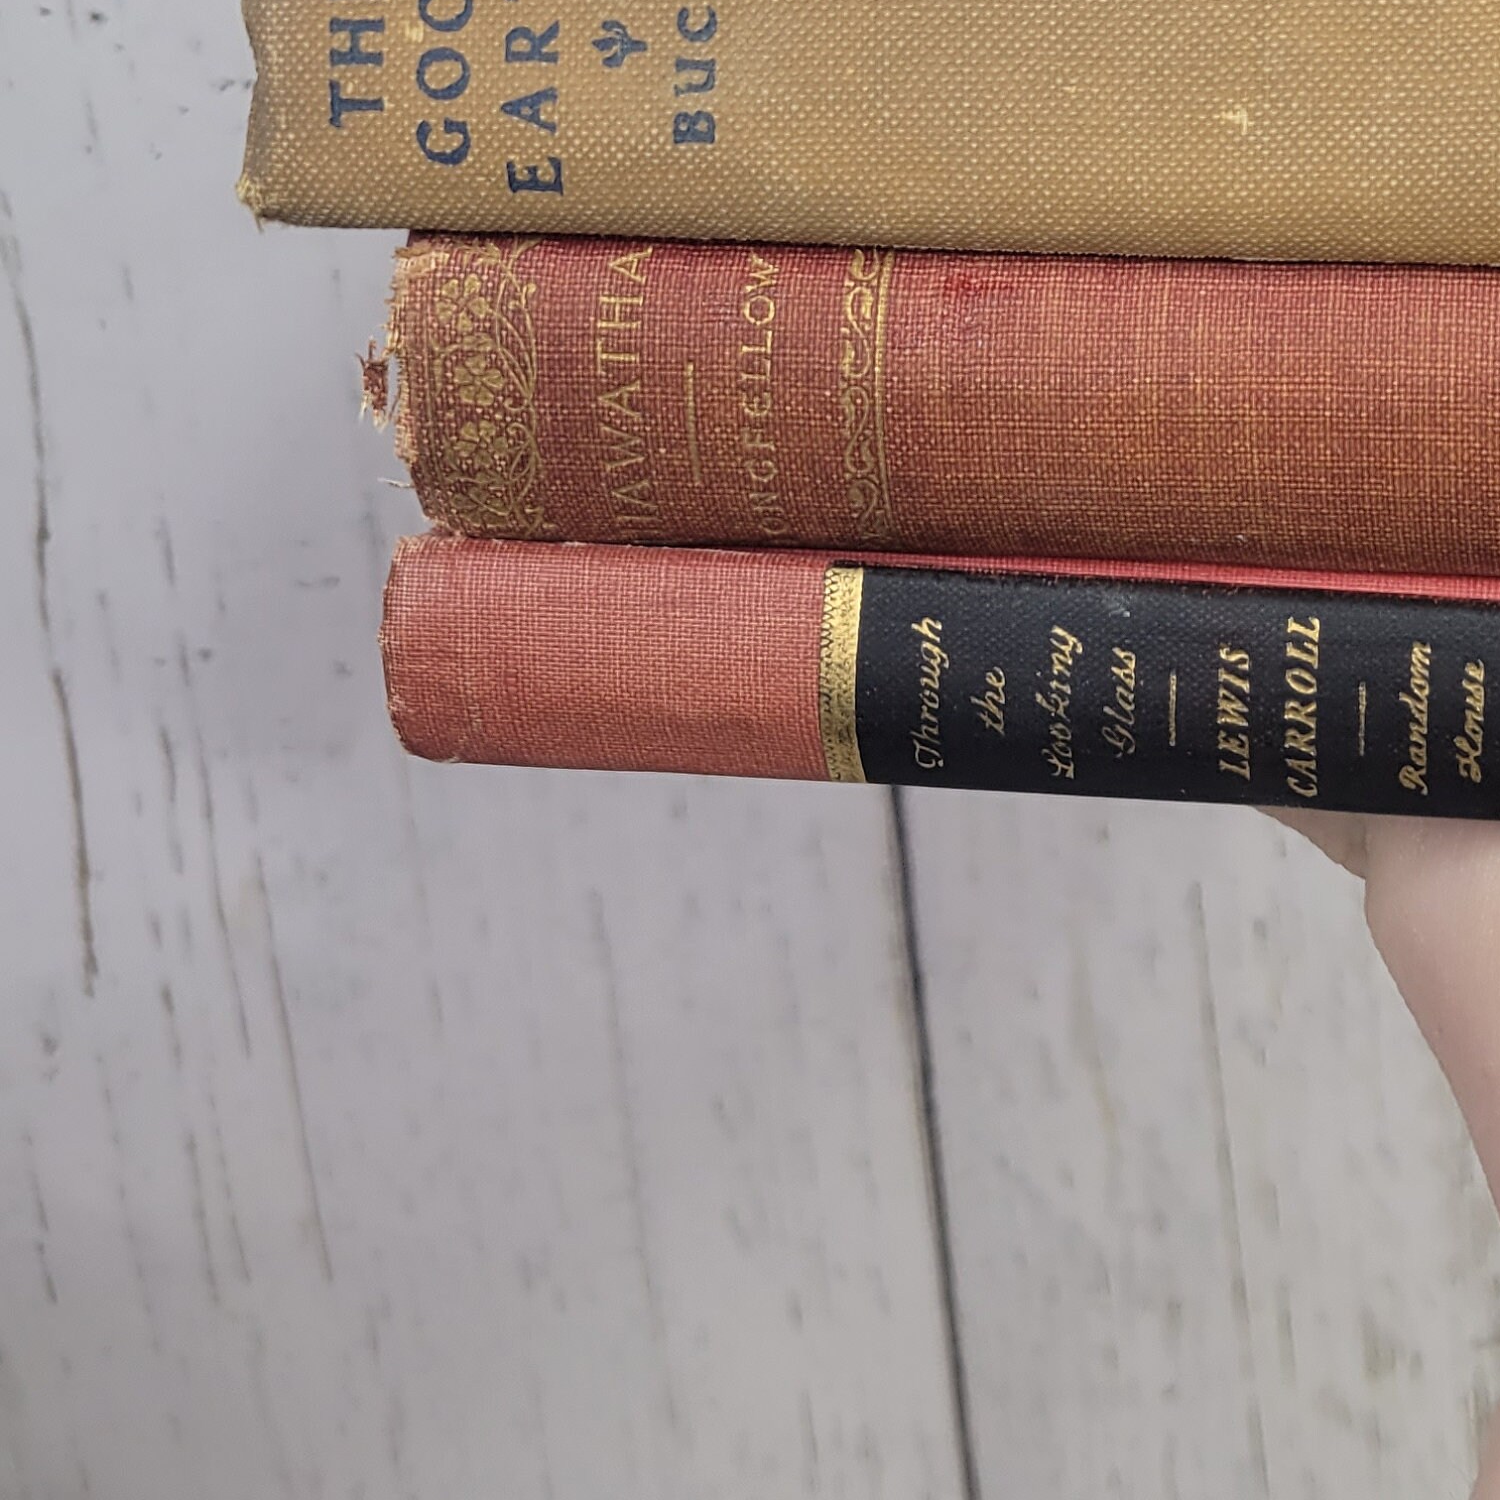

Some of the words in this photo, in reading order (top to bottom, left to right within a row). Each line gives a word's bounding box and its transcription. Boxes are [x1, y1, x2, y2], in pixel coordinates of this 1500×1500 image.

[740, 253, 791, 536] ONGFELLOW
[911, 616, 949, 769] Through
[971, 666, 1006, 736] the
[1036, 625, 1083, 780] Looking
[1103, 647, 1136, 758] Glass
[1217, 642, 1251, 781] LEWIS
[1284, 616, 1320, 797] CARROLL
[1399, 640, 1432, 796] Random
[1454, 659, 1485, 784] House
